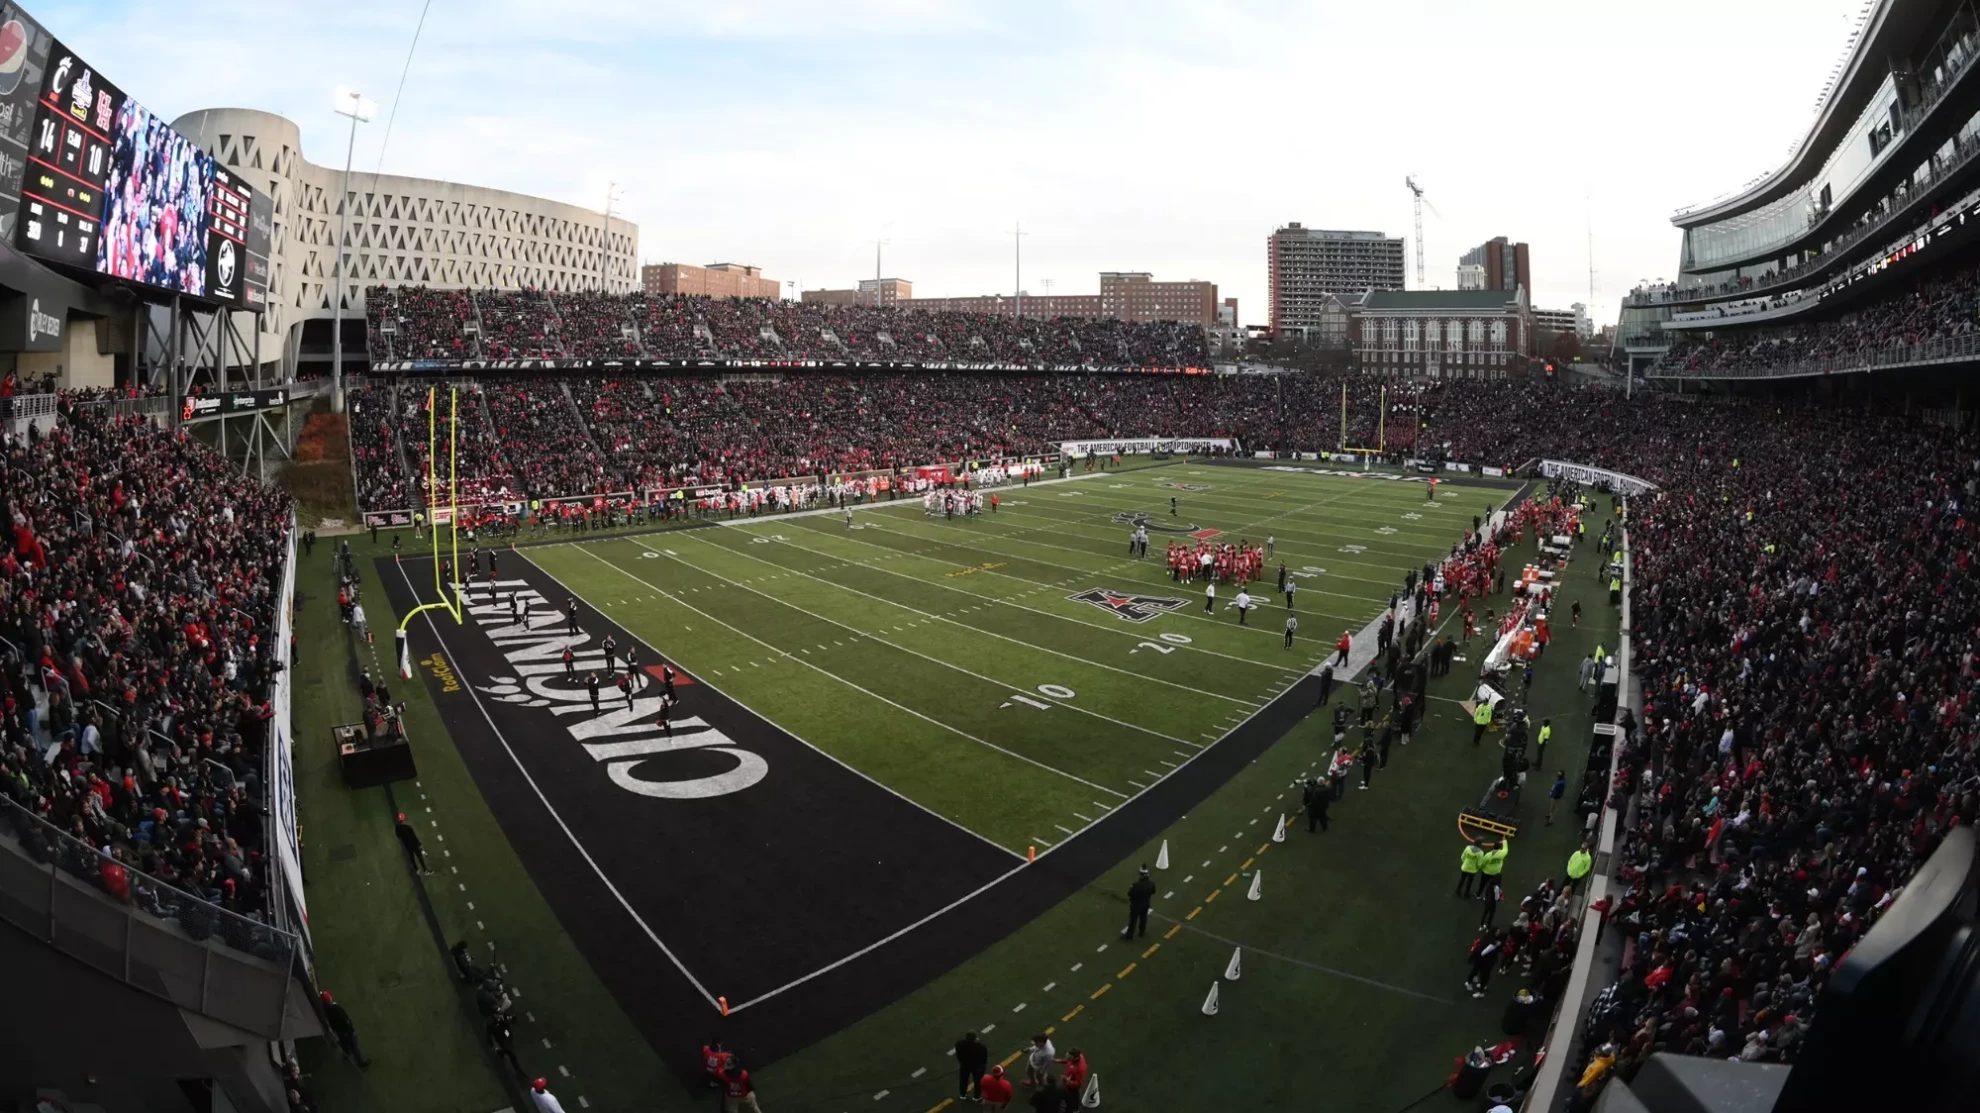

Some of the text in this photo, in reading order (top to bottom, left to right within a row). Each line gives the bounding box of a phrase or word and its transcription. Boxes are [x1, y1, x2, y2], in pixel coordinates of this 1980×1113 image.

[40, 118, 55, 152] 14
[88, 144, 102, 175] 10
[1077, 443, 1089, 453] THE
[1090, 442, 1123, 453] AMERICAN
[1124, 441, 1154, 451] FOOTBALL
[1547, 463, 1559, 475] THE
[1560, 465, 1593, 482] AMERICAN
[447, 578, 769, 799] CINCINNATI
[1008, 684, 1076, 711] 10
